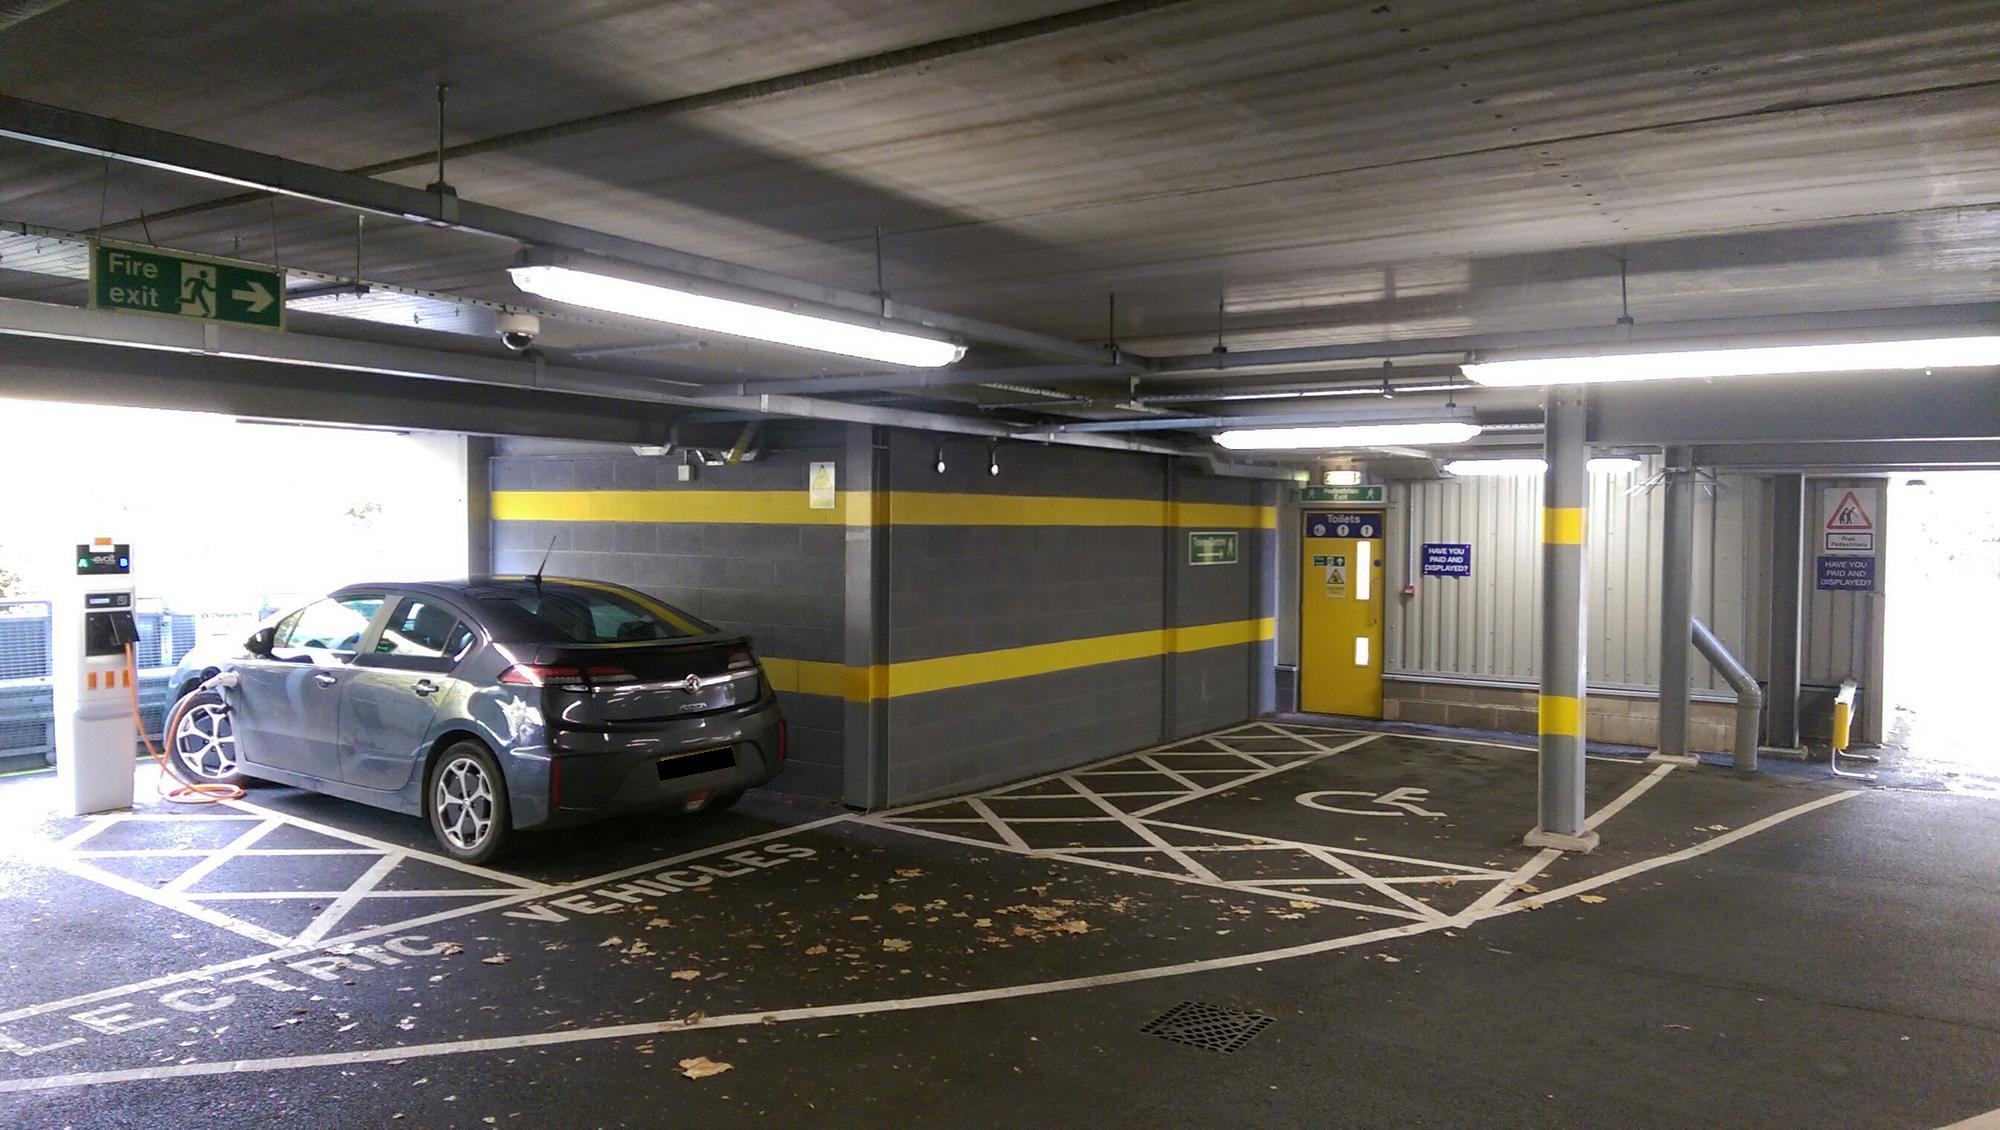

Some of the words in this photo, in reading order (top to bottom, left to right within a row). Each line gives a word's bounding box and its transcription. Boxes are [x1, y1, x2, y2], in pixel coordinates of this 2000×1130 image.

[109, 252, 159, 279] Fire
[109, 286, 159, 308] exit
[1327, 514, 1361, 524] Toilets
[1428, 547, 1448, 555] HAVE
[1447, 556, 1464, 564] AND
[1424, 564, 1469, 572] DISPLAYED?
[1848, 561, 1868, 569] YOU
[1847, 570, 1866, 578] AND
[1820, 579, 1872, 587] DISPLAYED?
[0, 935, 446, 1057] LECTRIC
[502, 843, 818, 923] VEHICLES
